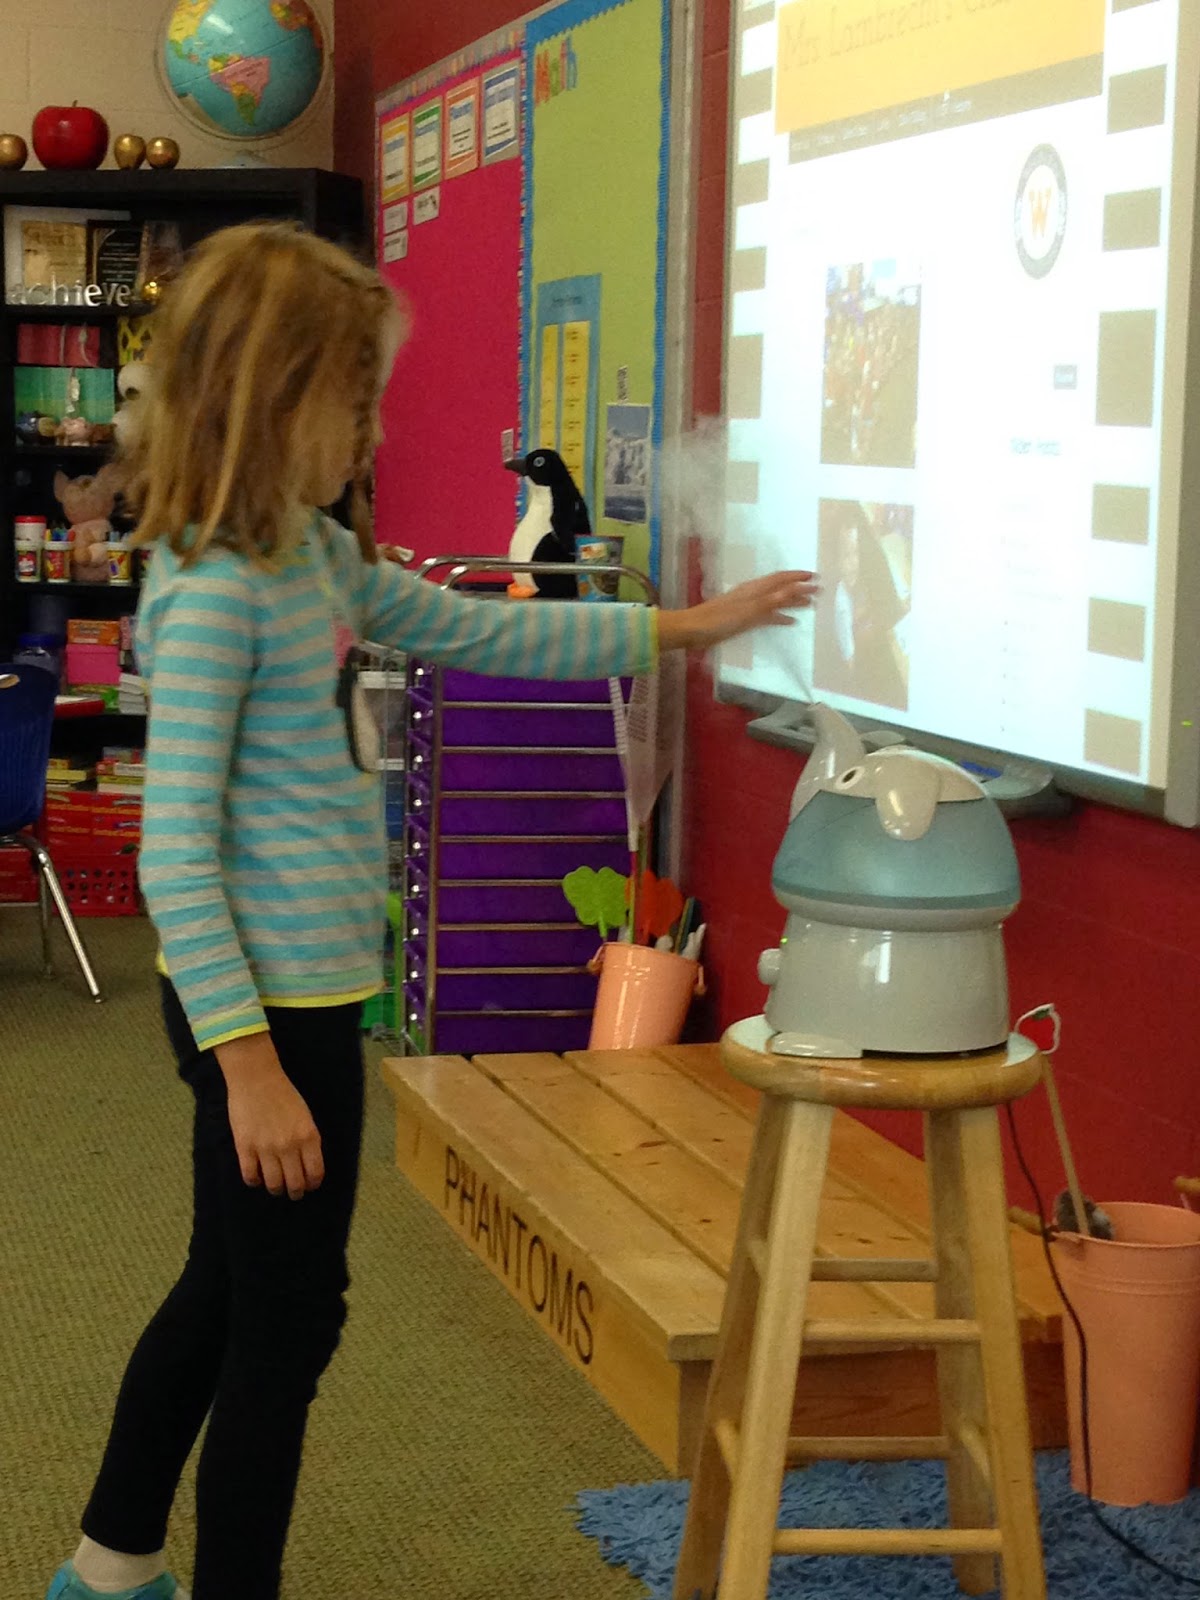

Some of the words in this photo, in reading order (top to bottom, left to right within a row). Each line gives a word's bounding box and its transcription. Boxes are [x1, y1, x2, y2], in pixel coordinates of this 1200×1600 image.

[1028, 188, 1053, 240] W
[8, 271, 131, 307] achieve
[444, 1144, 594, 1365] PHANTOMS
